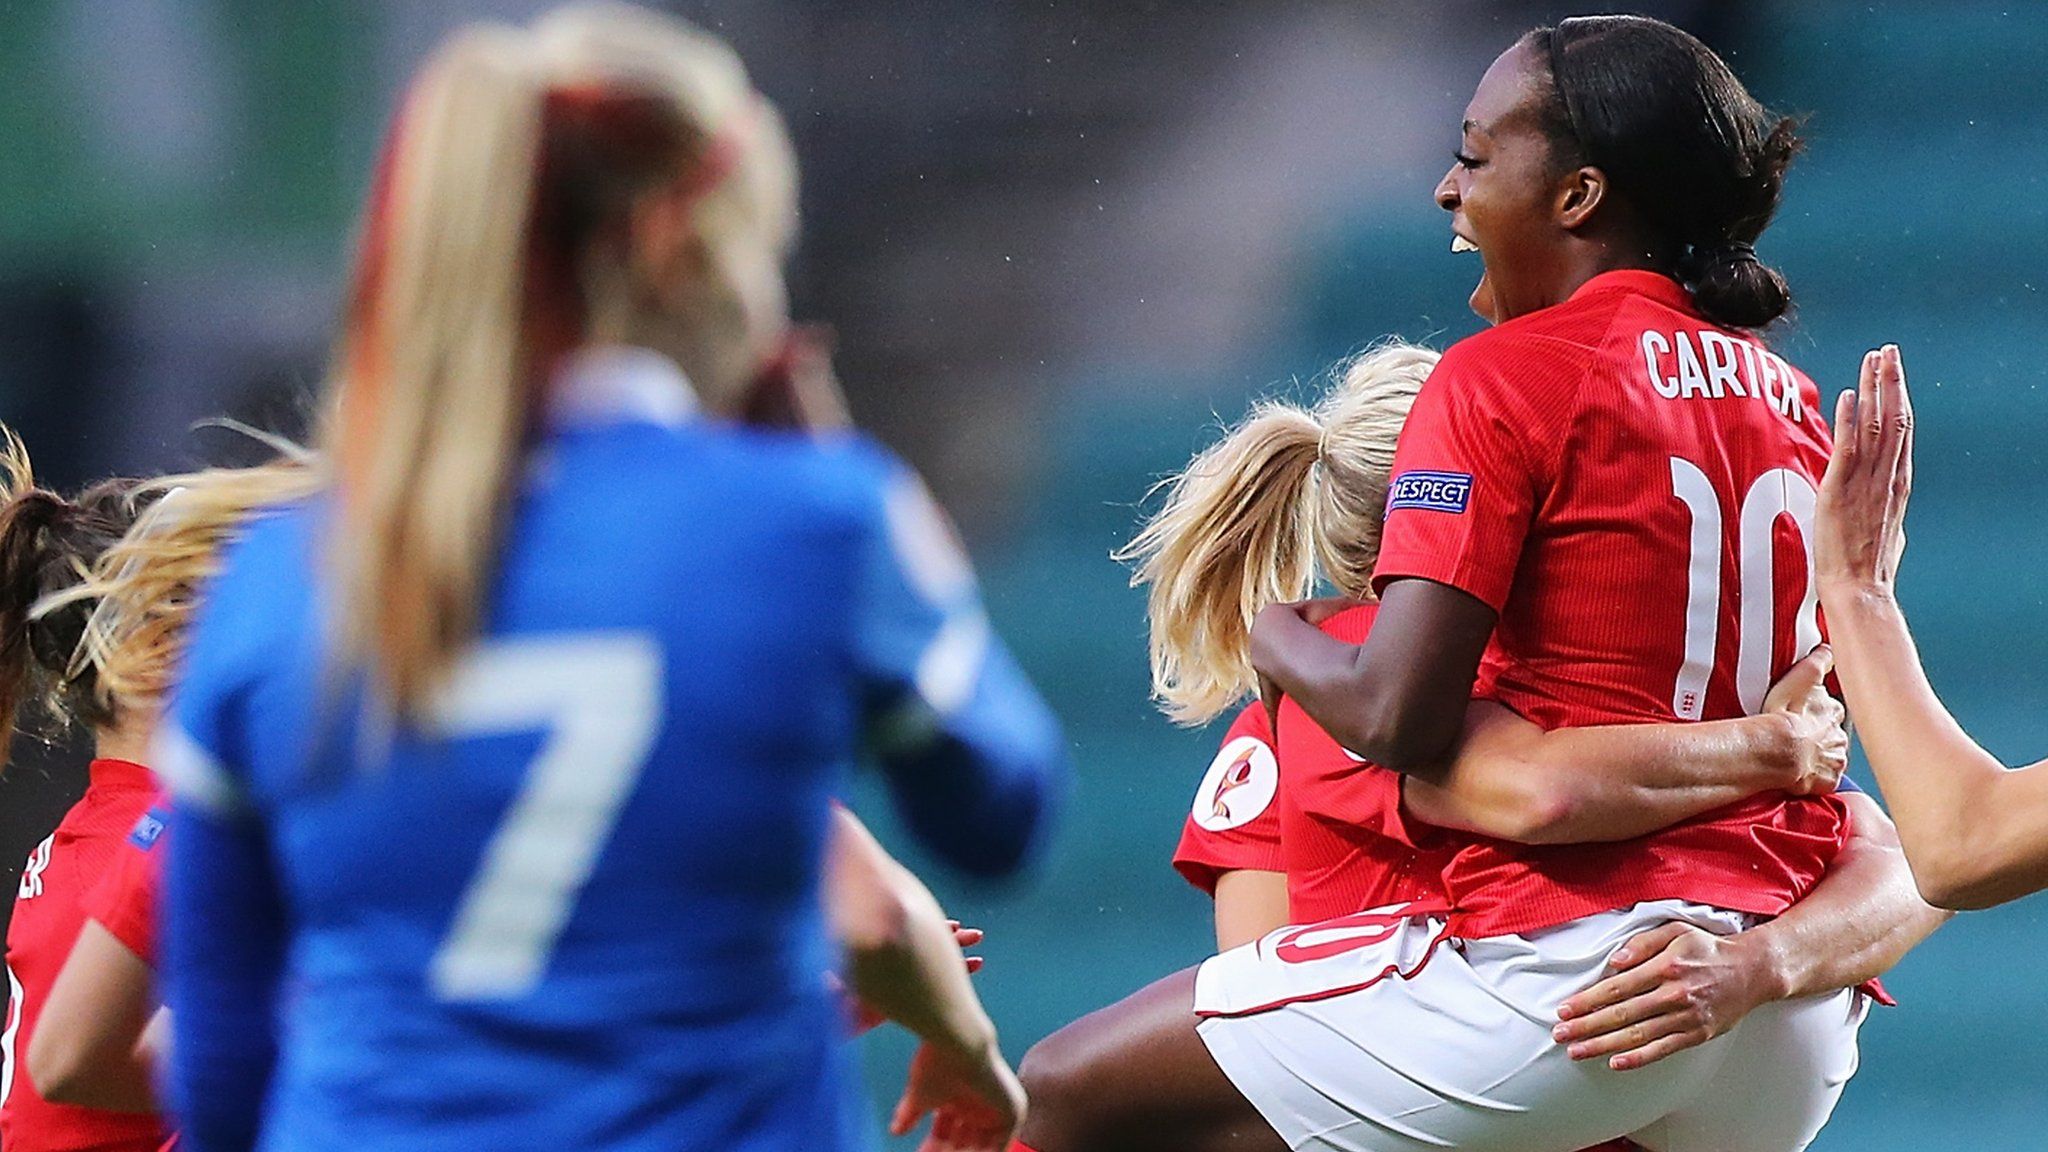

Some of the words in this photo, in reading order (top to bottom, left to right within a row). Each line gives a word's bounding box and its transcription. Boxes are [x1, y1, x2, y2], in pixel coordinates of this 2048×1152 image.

[1641, 330, 1802, 422] CARTER
[1669, 456, 1823, 721] 10
[429, 630, 664, 1002] 7
